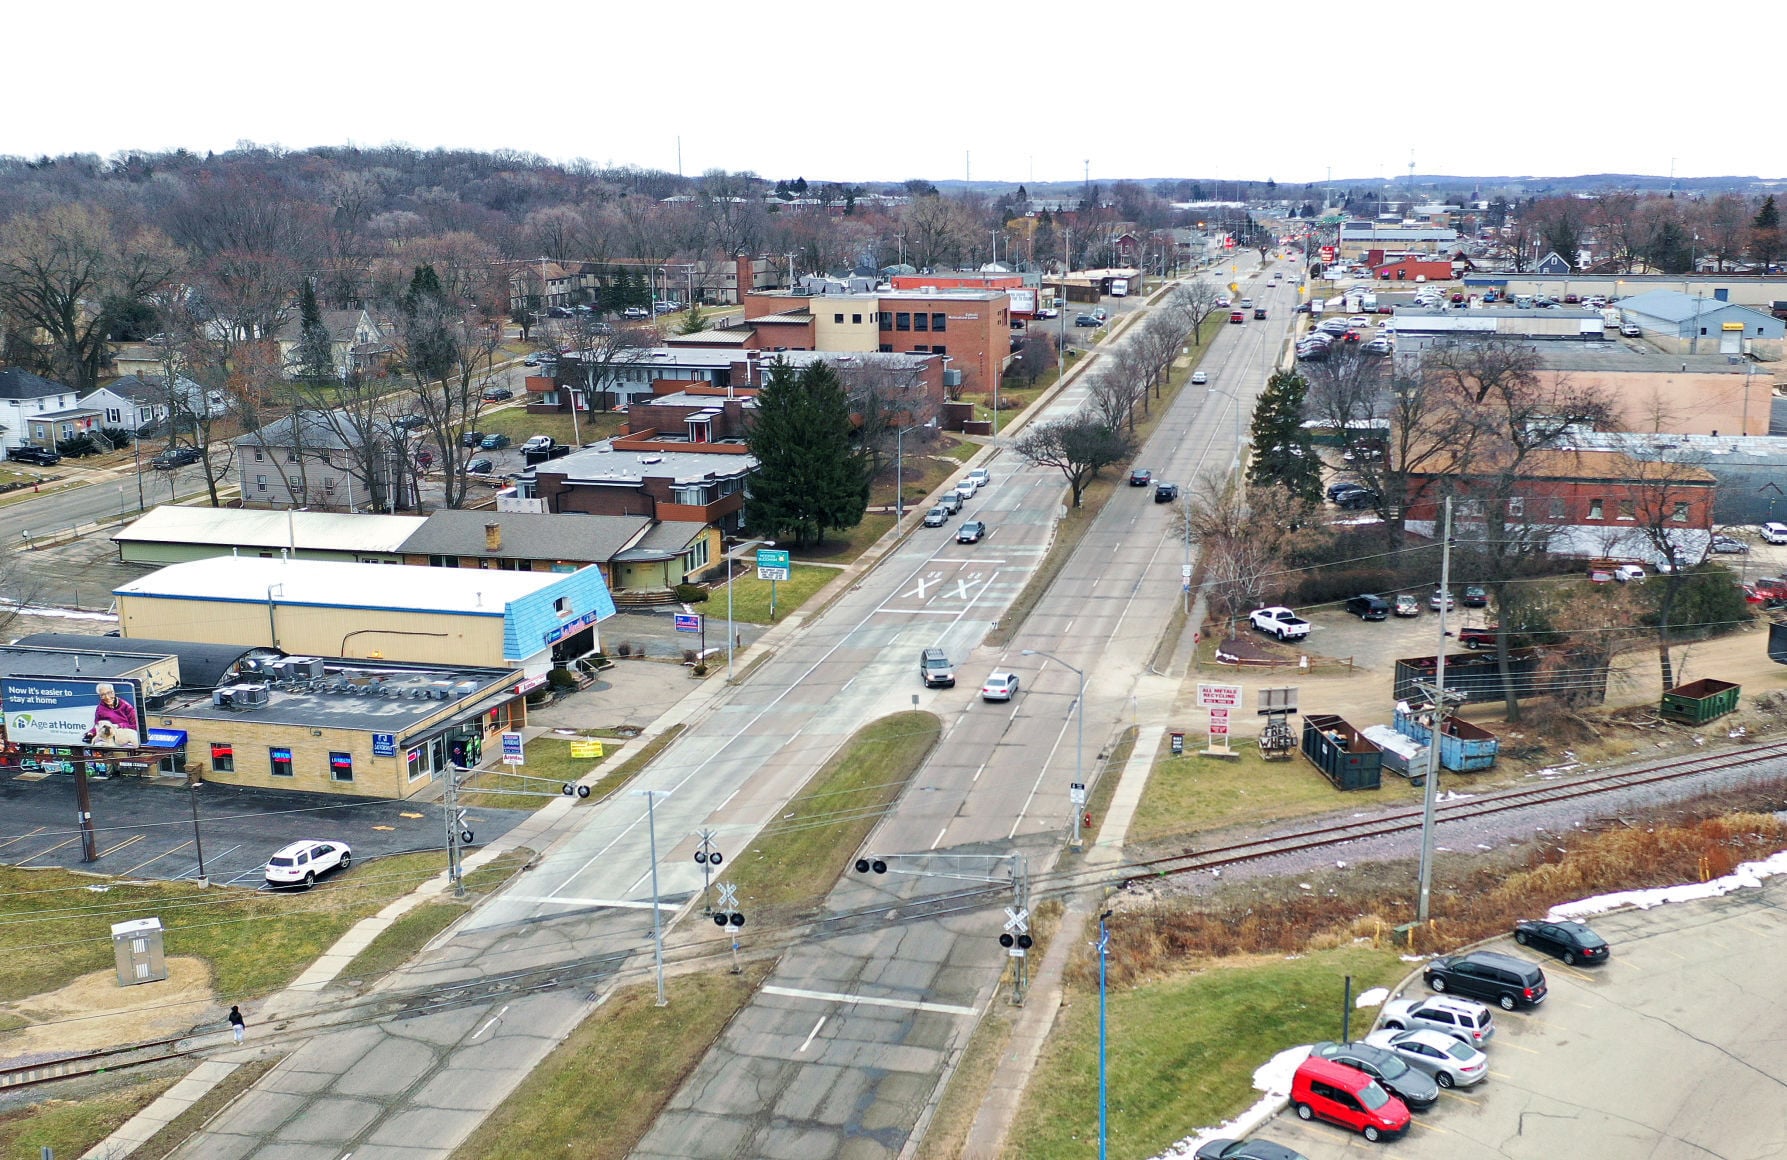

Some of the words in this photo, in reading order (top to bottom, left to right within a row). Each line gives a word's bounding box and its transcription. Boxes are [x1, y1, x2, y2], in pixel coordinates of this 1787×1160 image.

[8, 686, 27, 694] Now
[28, 687, 39, 695] it's
[9, 696, 25, 704] stay
[36, 696, 57, 704] home
[31, 719, 48, 729] Age
[59, 721, 87, 729] Home
[1264, 725, 1291, 736] FREE
[1260, 736, 1298, 749] WHEEL
